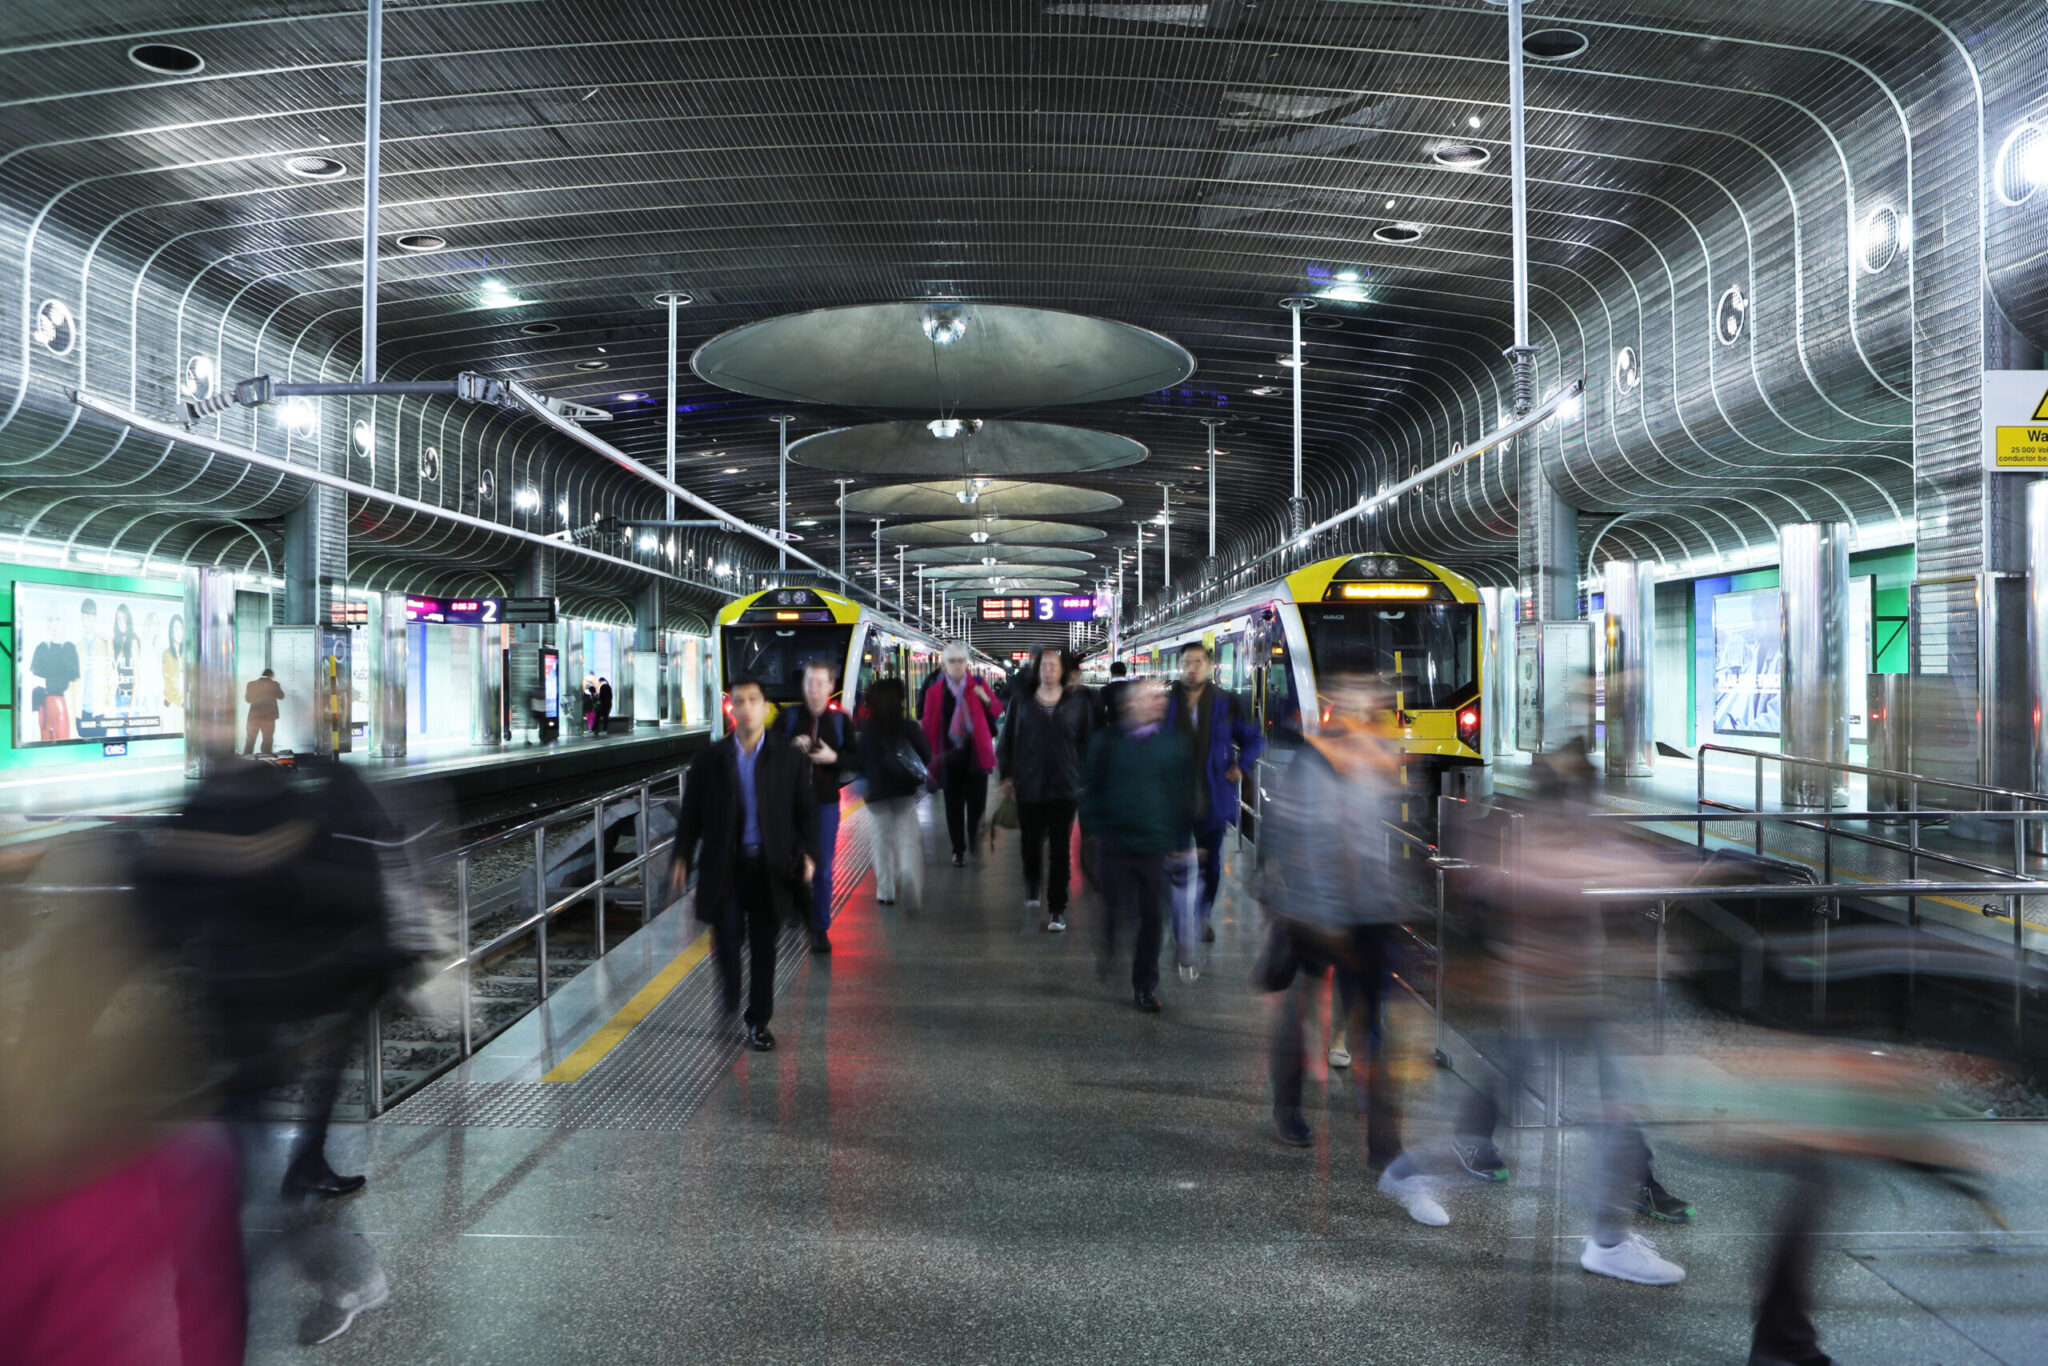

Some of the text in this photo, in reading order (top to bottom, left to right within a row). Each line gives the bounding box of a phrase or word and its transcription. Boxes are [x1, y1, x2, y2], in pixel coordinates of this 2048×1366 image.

[2027, 430, 2048, 442] Wa
[482, 600, 497, 622] 2
[1039, 597, 1054, 620] 3
[81, 720, 97, 729] HAIR
